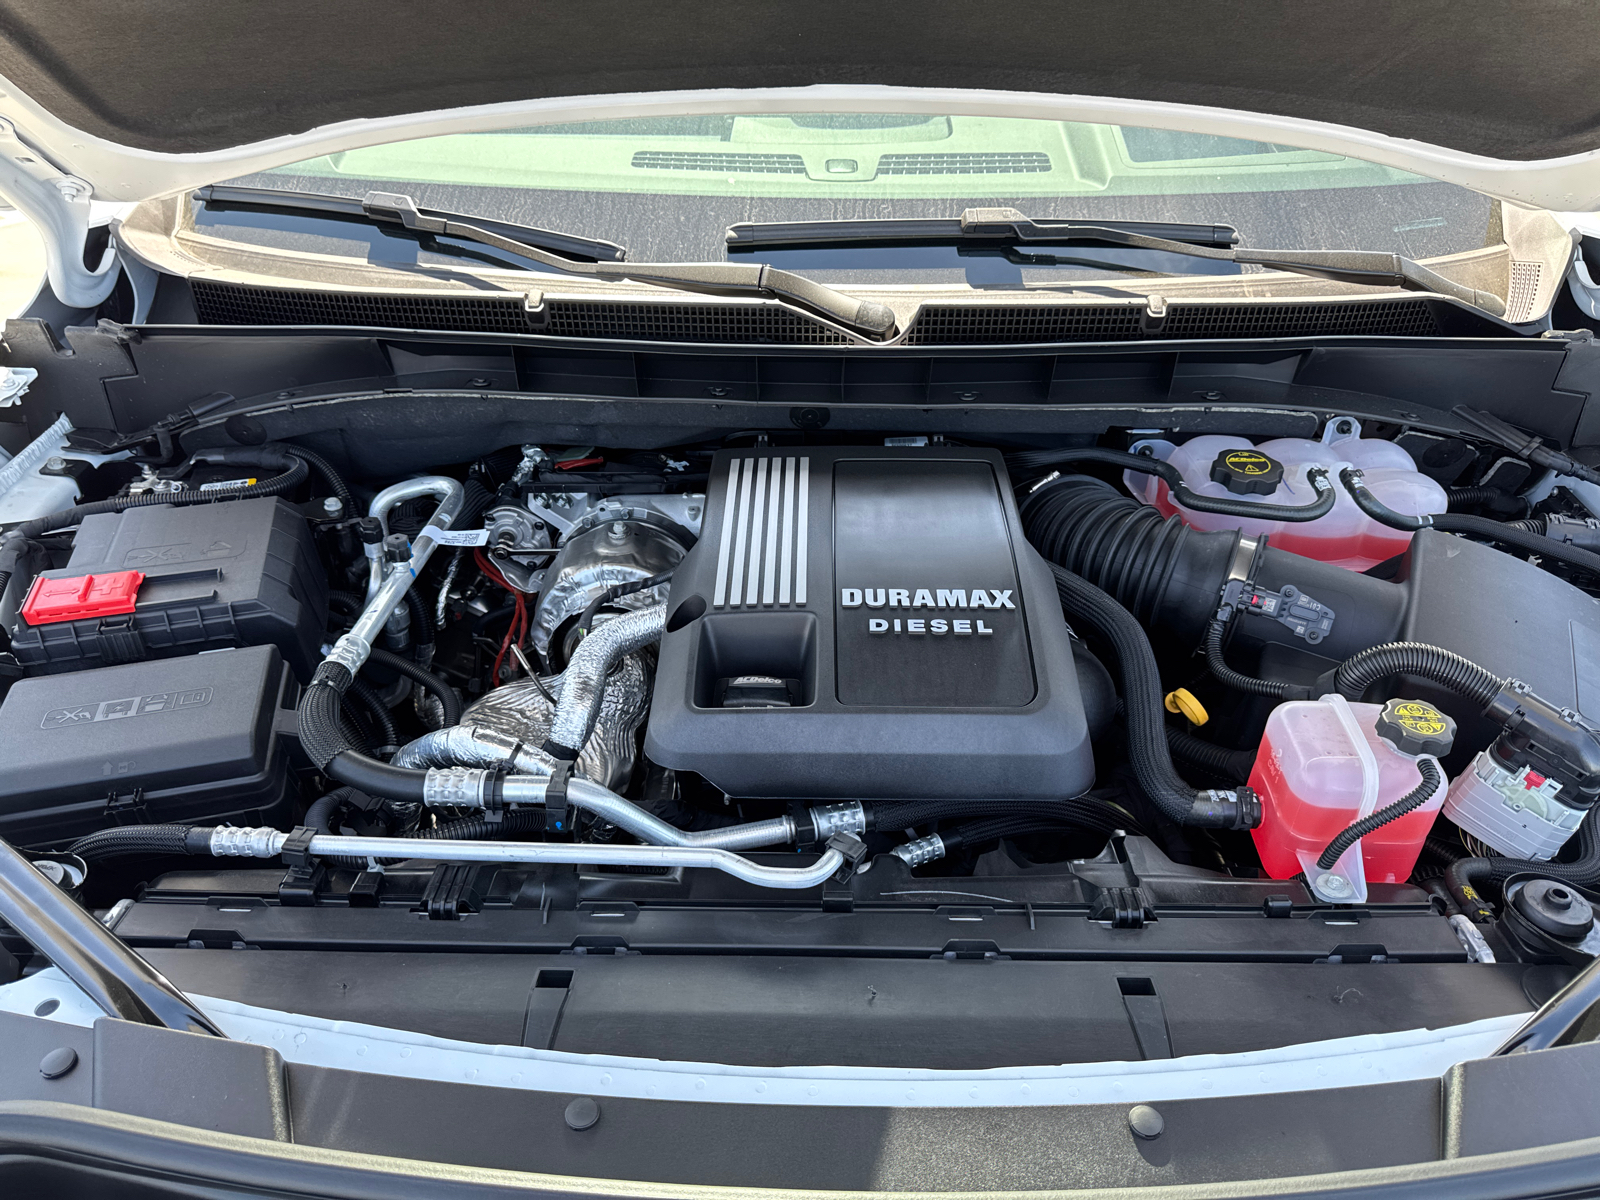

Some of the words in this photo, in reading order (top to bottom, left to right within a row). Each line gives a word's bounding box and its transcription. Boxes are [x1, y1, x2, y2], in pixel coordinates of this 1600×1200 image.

[841, 588, 1016, 609] DURAMAX
[869, 618, 993, 635] DIESEL
[733, 676, 782, 685] ACDelco
